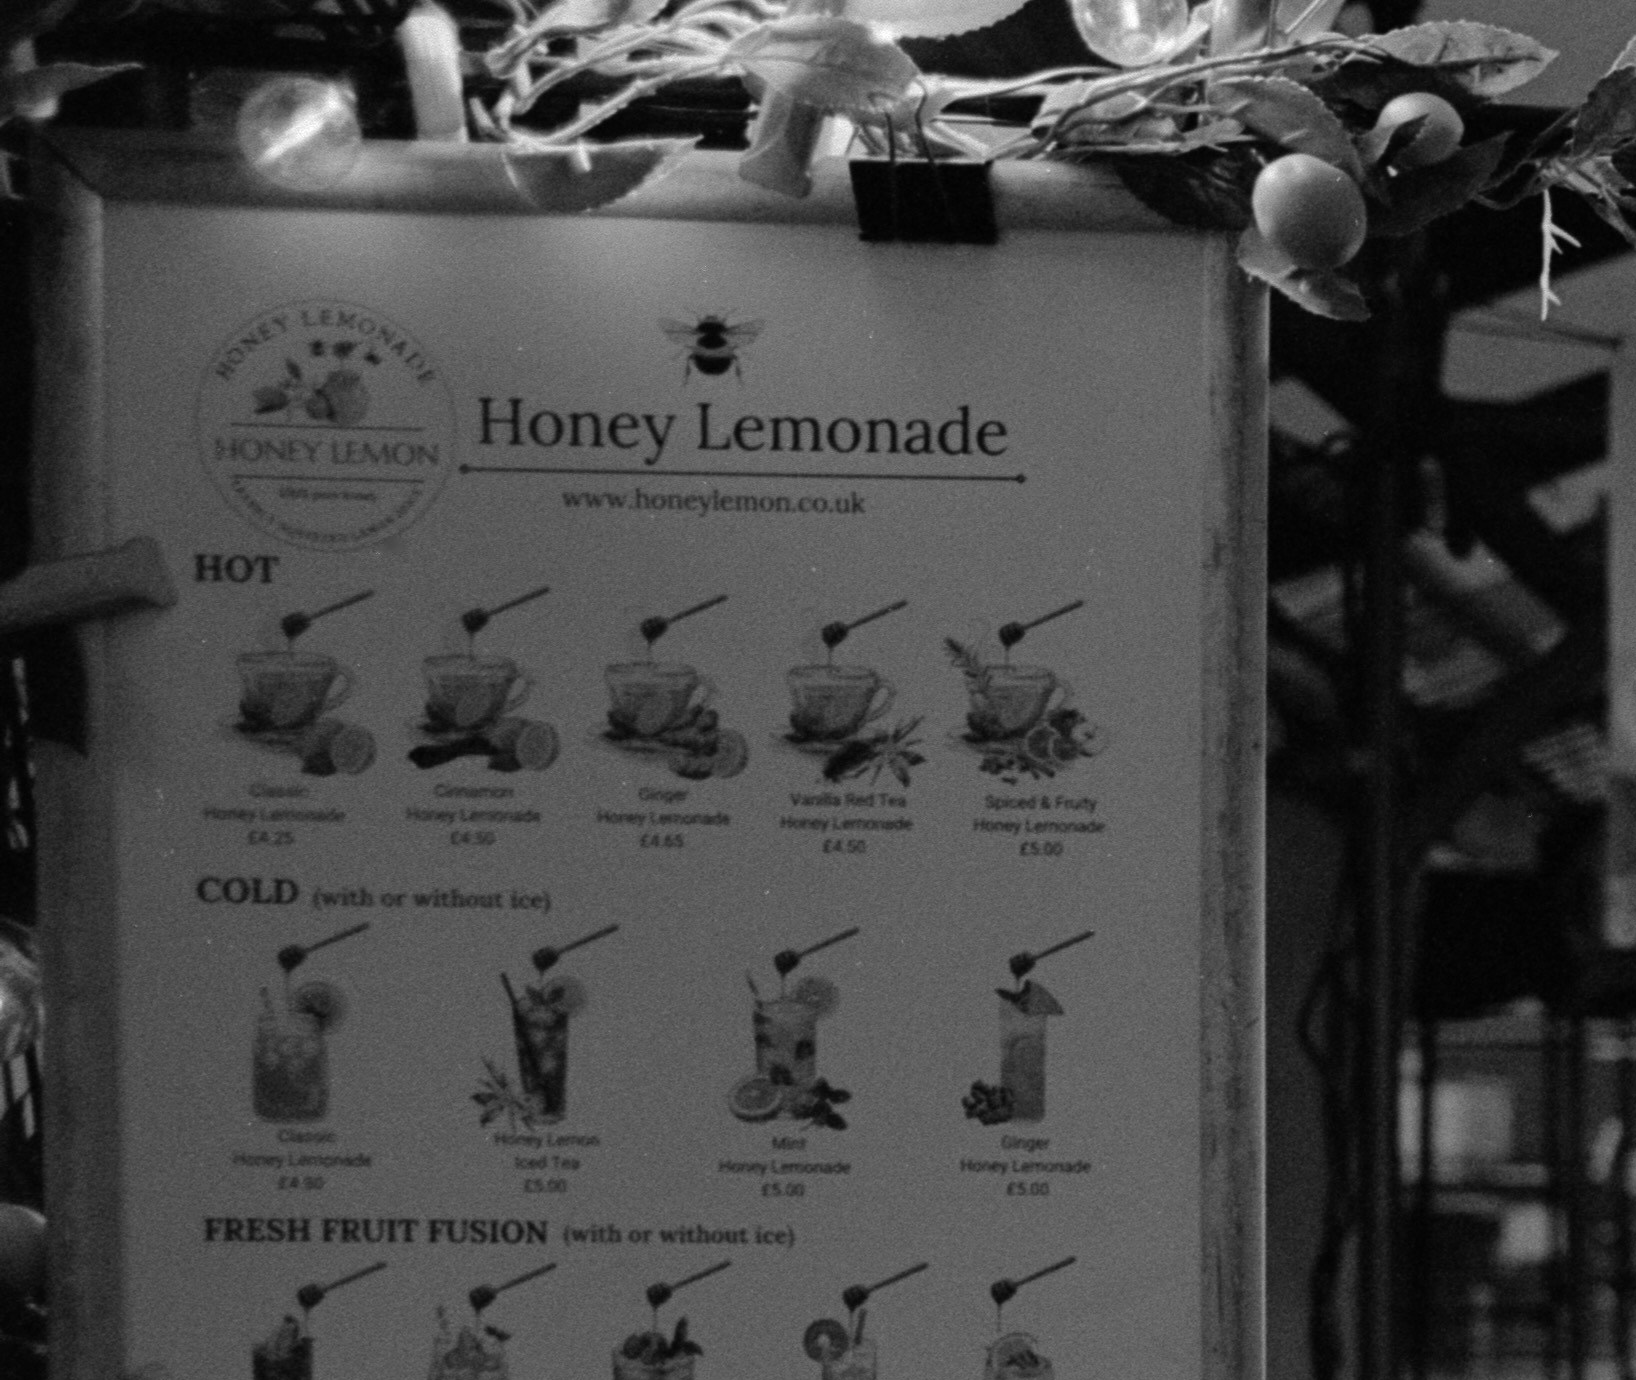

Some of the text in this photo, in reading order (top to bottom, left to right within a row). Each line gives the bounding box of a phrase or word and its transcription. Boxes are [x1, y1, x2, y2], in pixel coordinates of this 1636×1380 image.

[214, 309, 436, 387] HONEY LEMONADE
[479, 397, 1008, 466] Honey Lemonade
[214, 438, 439, 466] HONEY LEMON
[561, 488, 866, 516] www.honeylemon.co.uk
[193, 552, 280, 585] HOT
[249, 783, 310, 800] Classic
[433, 783, 515, 799] Cinnamon
[638, 786, 690, 805] Ginger
[790, 792, 907, 809] Vanilla Red Tea
[985, 794, 1098, 814] Spiced & Fruity
[203, 806, 346, 824] Honey Lemonade
[405, 806, 542, 825] Honey Lemonade
[597, 810, 731, 828] Honey Lemonade
[780, 815, 913, 833] Honey Lemonade
[973, 818, 1105, 836] Honey Lemonade
[1019, 841, 1064, 857] £5.00
[196, 876, 551, 913] COLD (with or without ice)
[277, 1128, 336, 1144] Classic
[494, 1131, 600, 1149] Honey Lemon
[771, 1136, 808, 1151] Mint
[1001, 1135, 1051, 1153] Ginger
[232, 1152, 372, 1169] Honey Lemonade
[514, 1155, 580, 1171] Iced Tea
[718, 1158, 851, 1176] Honey Lemonade
[960, 1158, 1091, 1175] Honey Lemonade
[761, 1182, 805, 1197] £5.00
[1006, 1181, 1050, 1197] £5.00
[203, 1216, 797, 1248] FRESH FRUIT FUSION (with or without ice)
